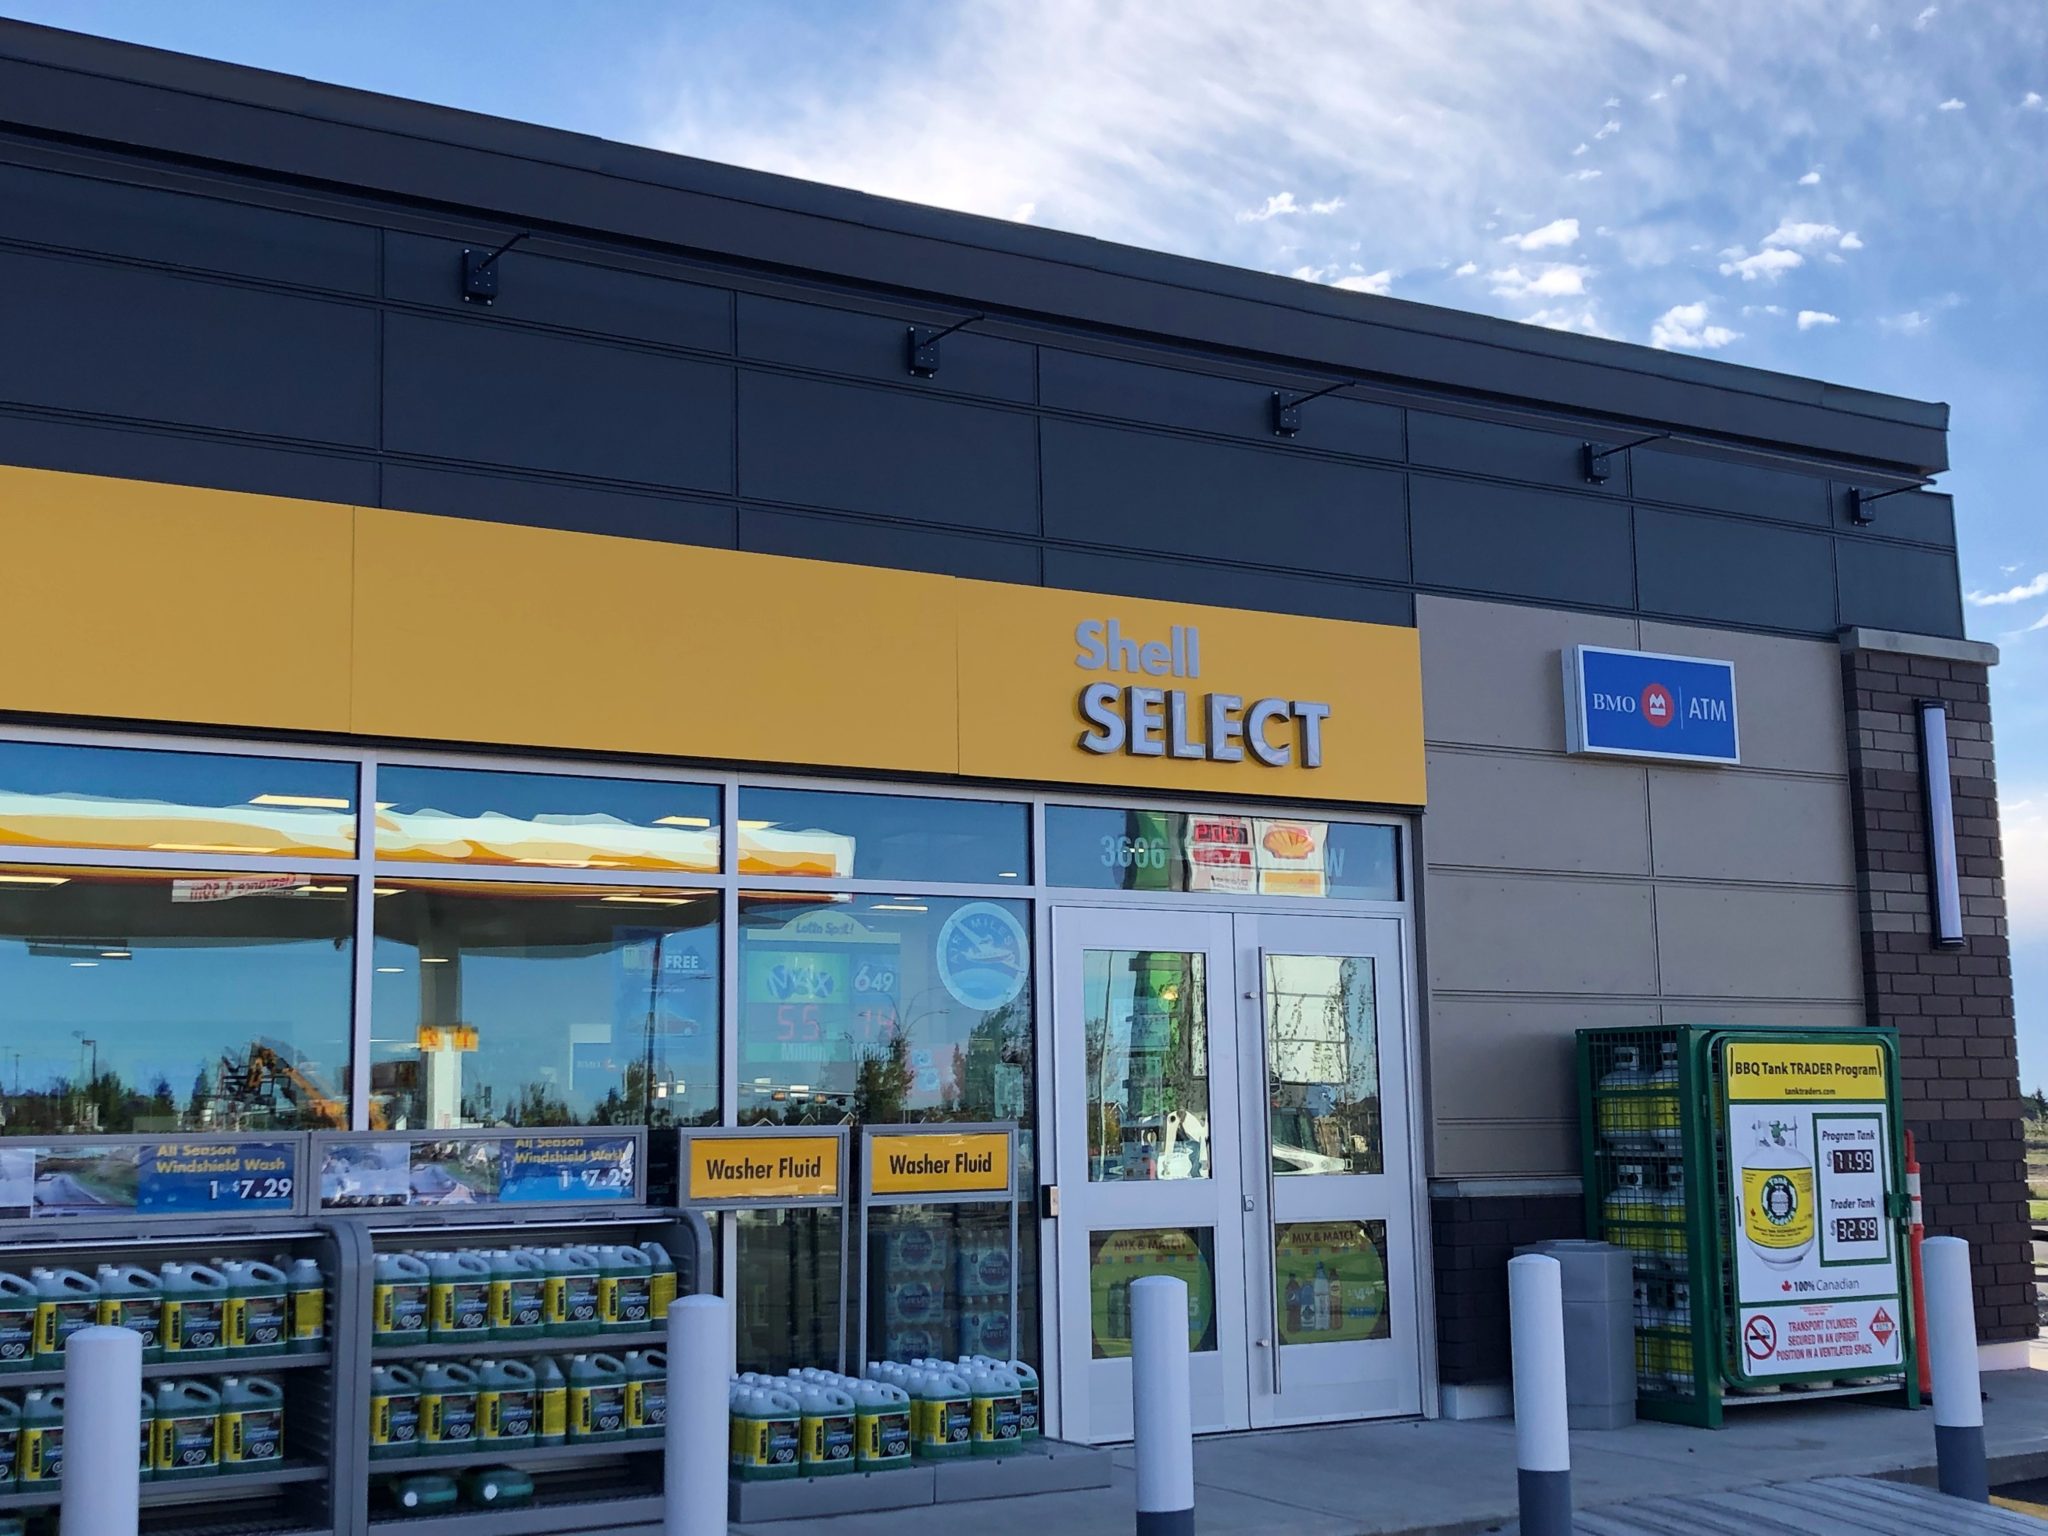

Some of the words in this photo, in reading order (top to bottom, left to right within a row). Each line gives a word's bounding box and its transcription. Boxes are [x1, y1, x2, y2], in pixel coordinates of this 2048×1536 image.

[1075, 618, 1199, 678] Shell
[1592, 693, 1636, 713] BMO
[1688, 697, 1727, 722] ATM
[1078, 681, 1331, 768] SELECT
[1101, 835, 1166, 869] 3606
[796, 922, 823, 935] Lotto
[825, 922, 854, 936] Spot!
[664, 955, 699, 969] FREE
[777, 1004, 822, 1041] 55
[1735, 1062, 1760, 1076] BBQ
[1762, 1062, 1788, 1075] Tank
[1790, 1063, 1833, 1075] TRADER
[1835, 1063, 1878, 1078] Program
[1784, 1087, 1836, 1096] tanktraders.com
[1822, 1130, 1855, 1143] Program
[1857, 1130, 1875, 1140] Tank
[156, 1145, 178, 1157] All
[182, 1144, 237, 1157] Season
[515, 1151, 586, 1163] Windshield
[156, 1158, 240, 1173] Windshield
[244, 1157, 285, 1171] Wash
[706, 1157, 773, 1180] Washer
[778, 1156, 821, 1178] Fluid
[889, 1154, 950, 1174] Washer
[955, 1152, 992, 1173] Fluid
[232, 1178, 293, 1199] $7.29
[1830, 1199, 1856, 1209] Trader
[1857, 1198, 1875, 1208] Tank
[1115, 1239, 1135, 1251] MIX
[1292, 1232, 1312, 1244] MIX
[1314, 1231, 1320, 1241] &
[1794, 1281, 1815, 1292] 100%
[1816, 1278, 1859, 1291] Canadian
[1788, 1320, 1824, 1332] TRANSPORT
[1826, 1318, 1857, 1330] CYLINDERS
[1788, 1335, 1815, 1346] SECURED
[1817, 1334, 1824, 1344] IN
[1826, 1333, 1834, 1343] AN
[1835, 1331, 1859, 1342] UPRIGHT
[1776, 1349, 1804, 1361] POSITION
[1806, 1348, 1812, 1358] IN
[1812, 1347, 1819, 1357] A
[1819, 1345, 1853, 1358] VENTILATED
[1854, 1343, 1873, 1355] SPACE
